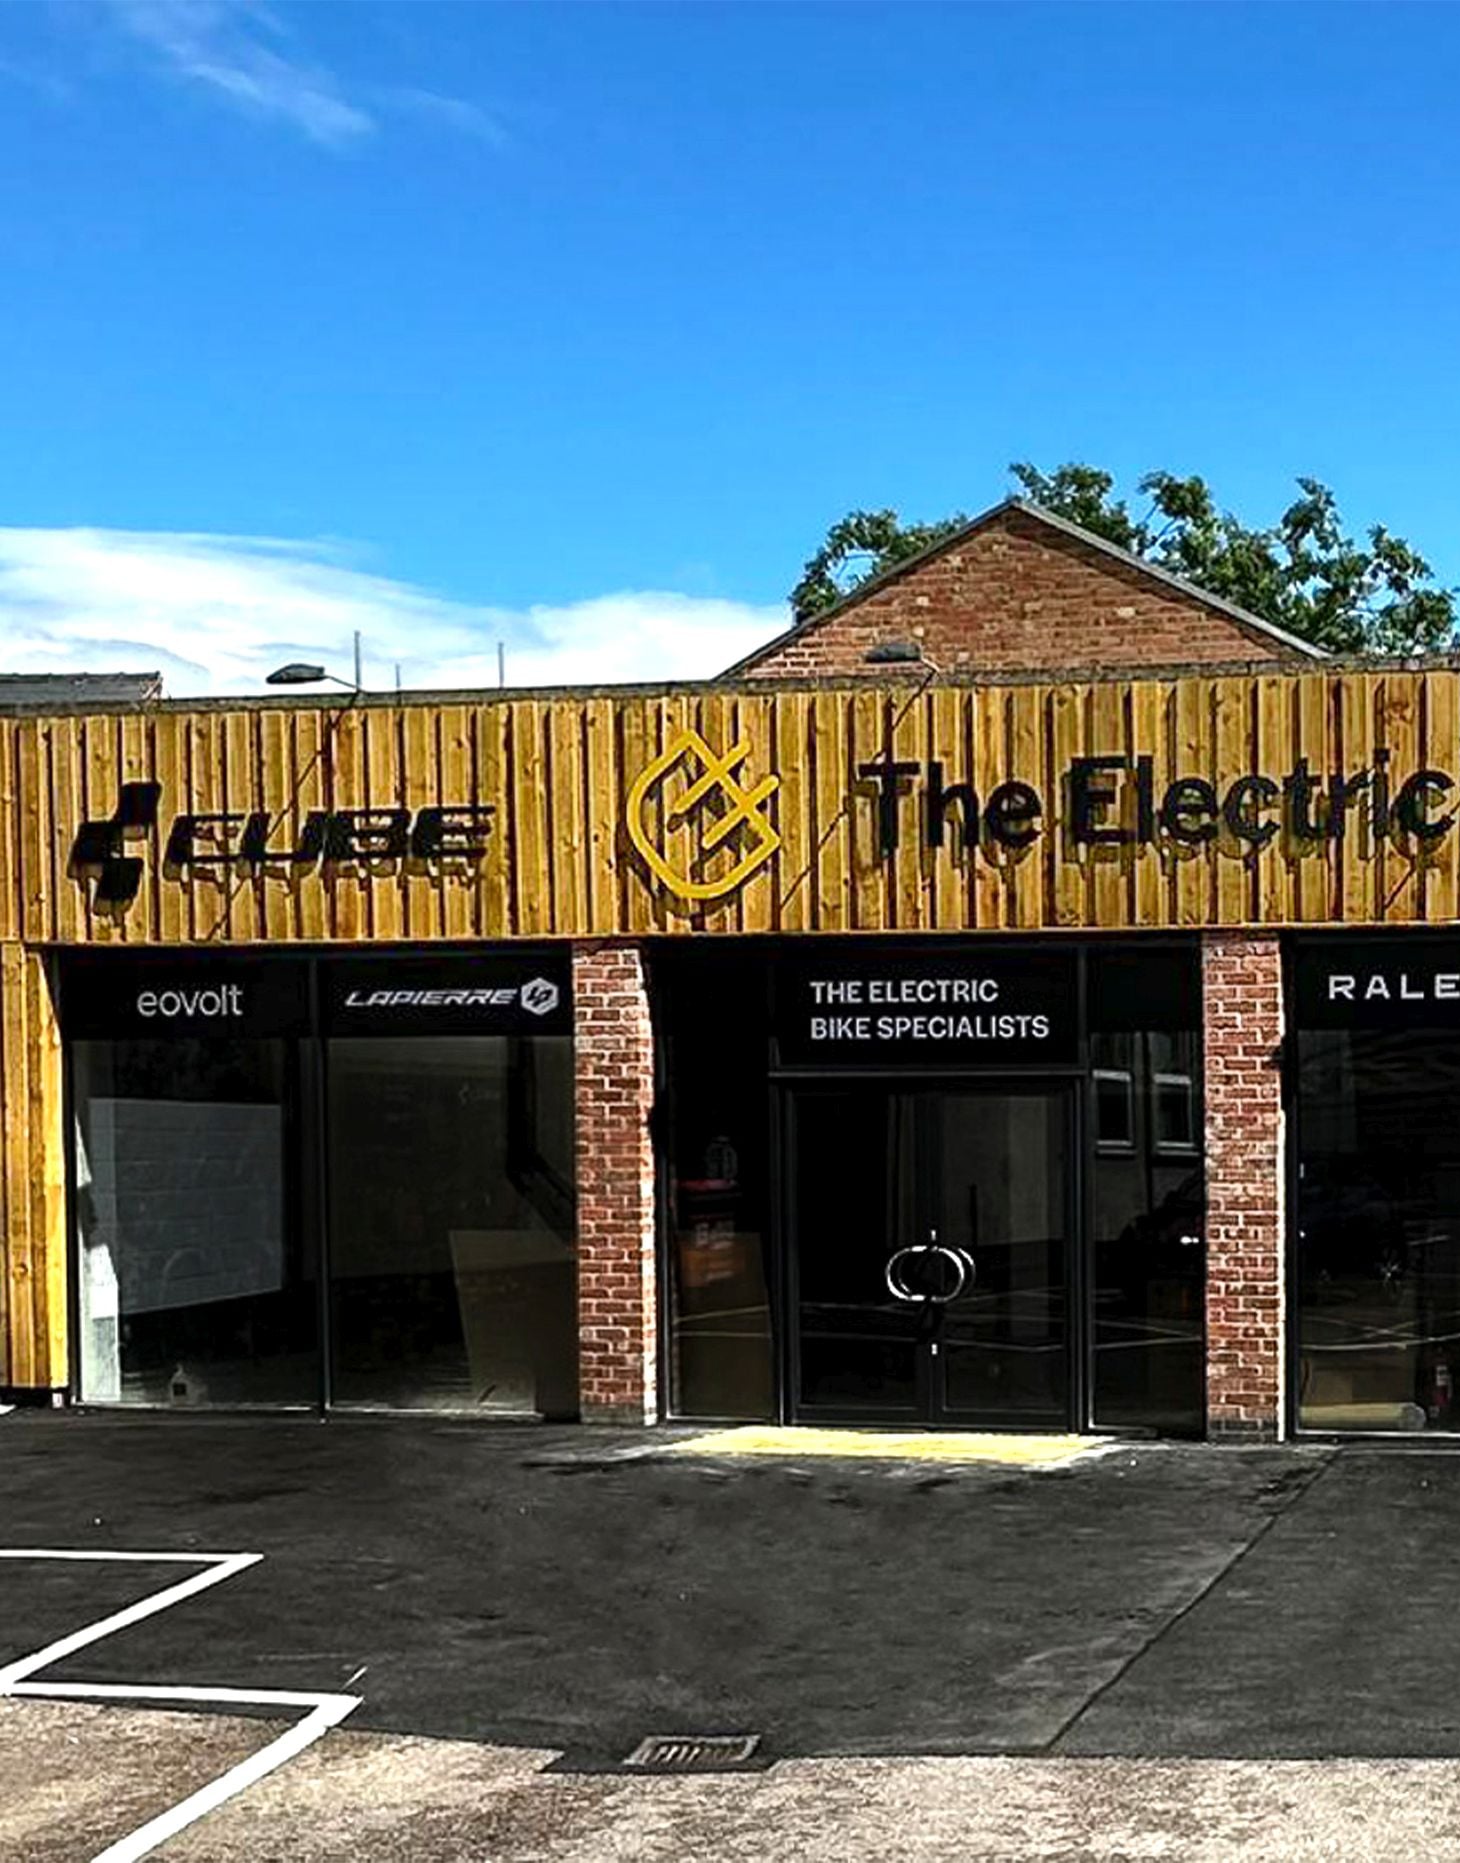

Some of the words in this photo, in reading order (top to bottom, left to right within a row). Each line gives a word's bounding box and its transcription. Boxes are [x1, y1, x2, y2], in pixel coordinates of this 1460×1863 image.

[857, 760, 1042, 850] The
[1070, 750, 1455, 846] Electric
[167, 805, 497, 863] CUBE
[136, 983, 243, 1017] eovolt
[344, 988, 518, 1007] LAPIERRE
[809, 979, 863, 1004] THE
[868, 978, 999, 1003] ELECTRIC
[810, 1016, 871, 1041] BIKE
[877, 1014, 1050, 1040] SPECIALISTS
